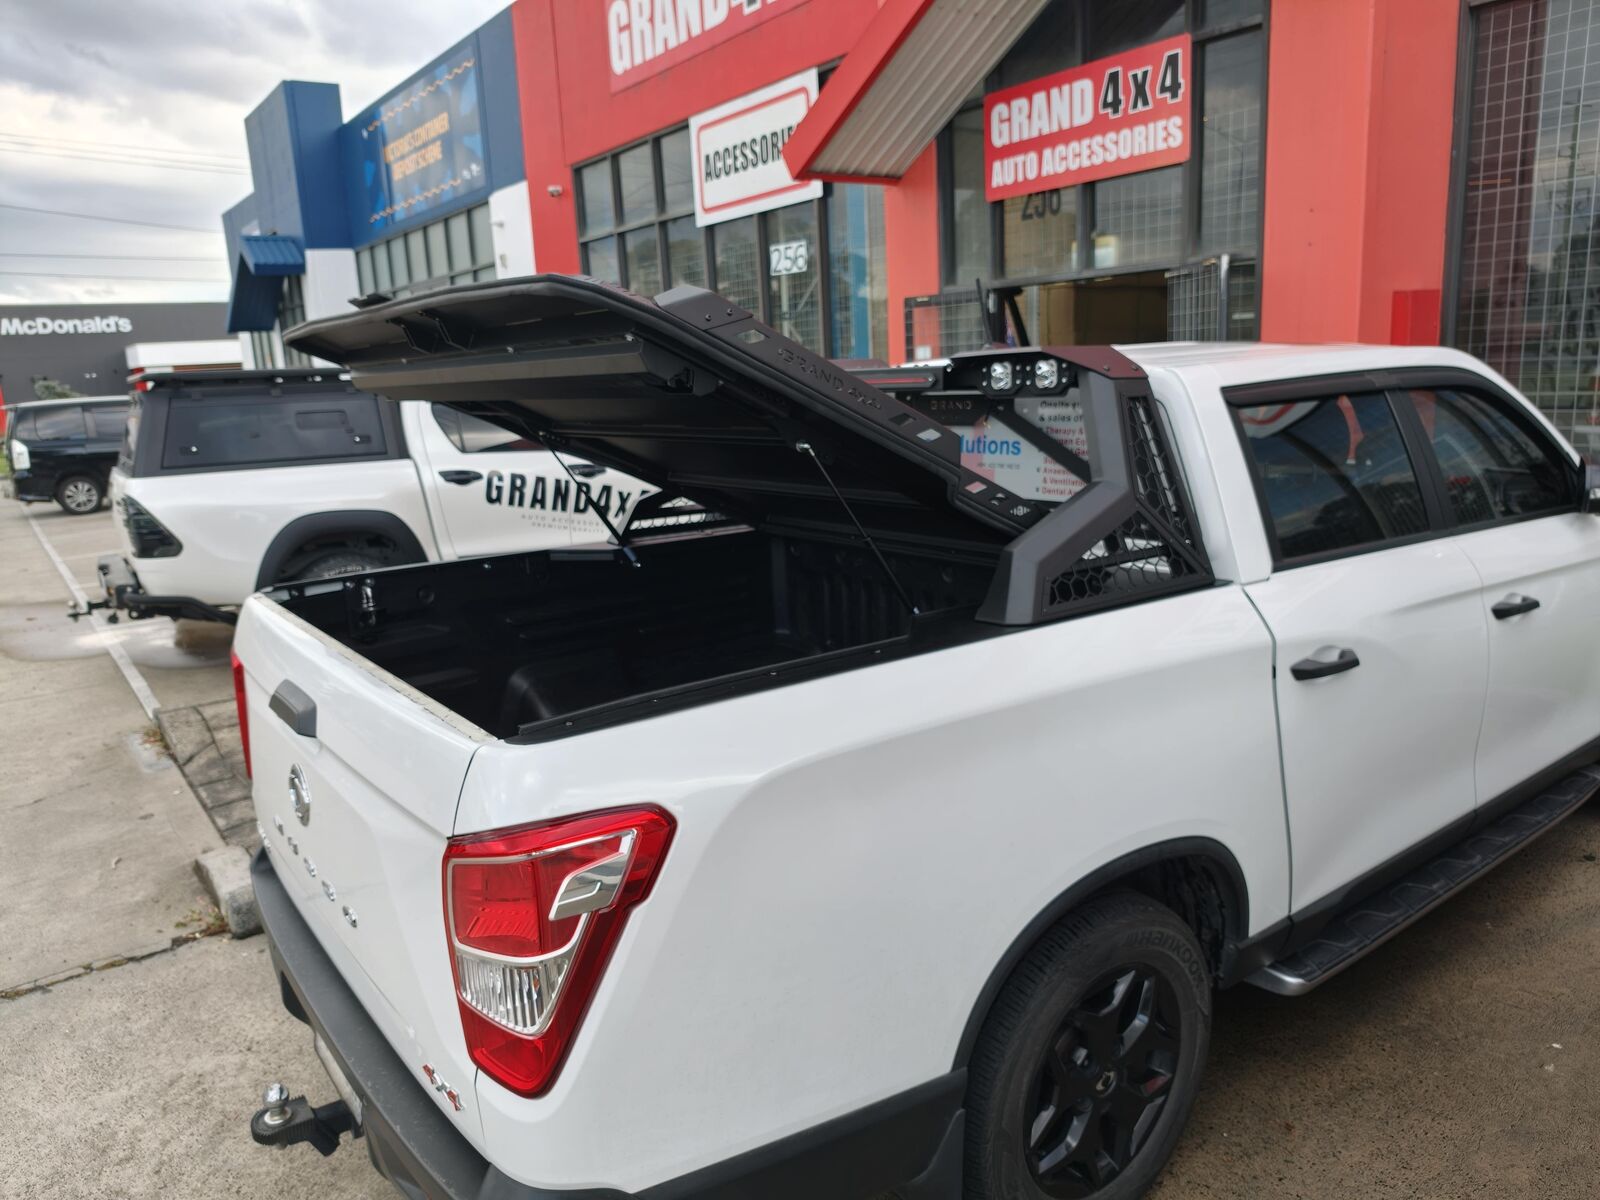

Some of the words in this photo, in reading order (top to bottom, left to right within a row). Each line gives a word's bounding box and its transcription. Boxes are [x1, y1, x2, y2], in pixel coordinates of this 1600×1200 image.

[990, 78, 1094, 148] GRAND
[704, 124, 794, 182] ACCESSORI
[991, 151, 1039, 188] AUTO
[1041, 115, 1183, 177] ACCESSORIES
[770, 244, 807, 273] 256
[0, 315, 133, 335] McDonald's
